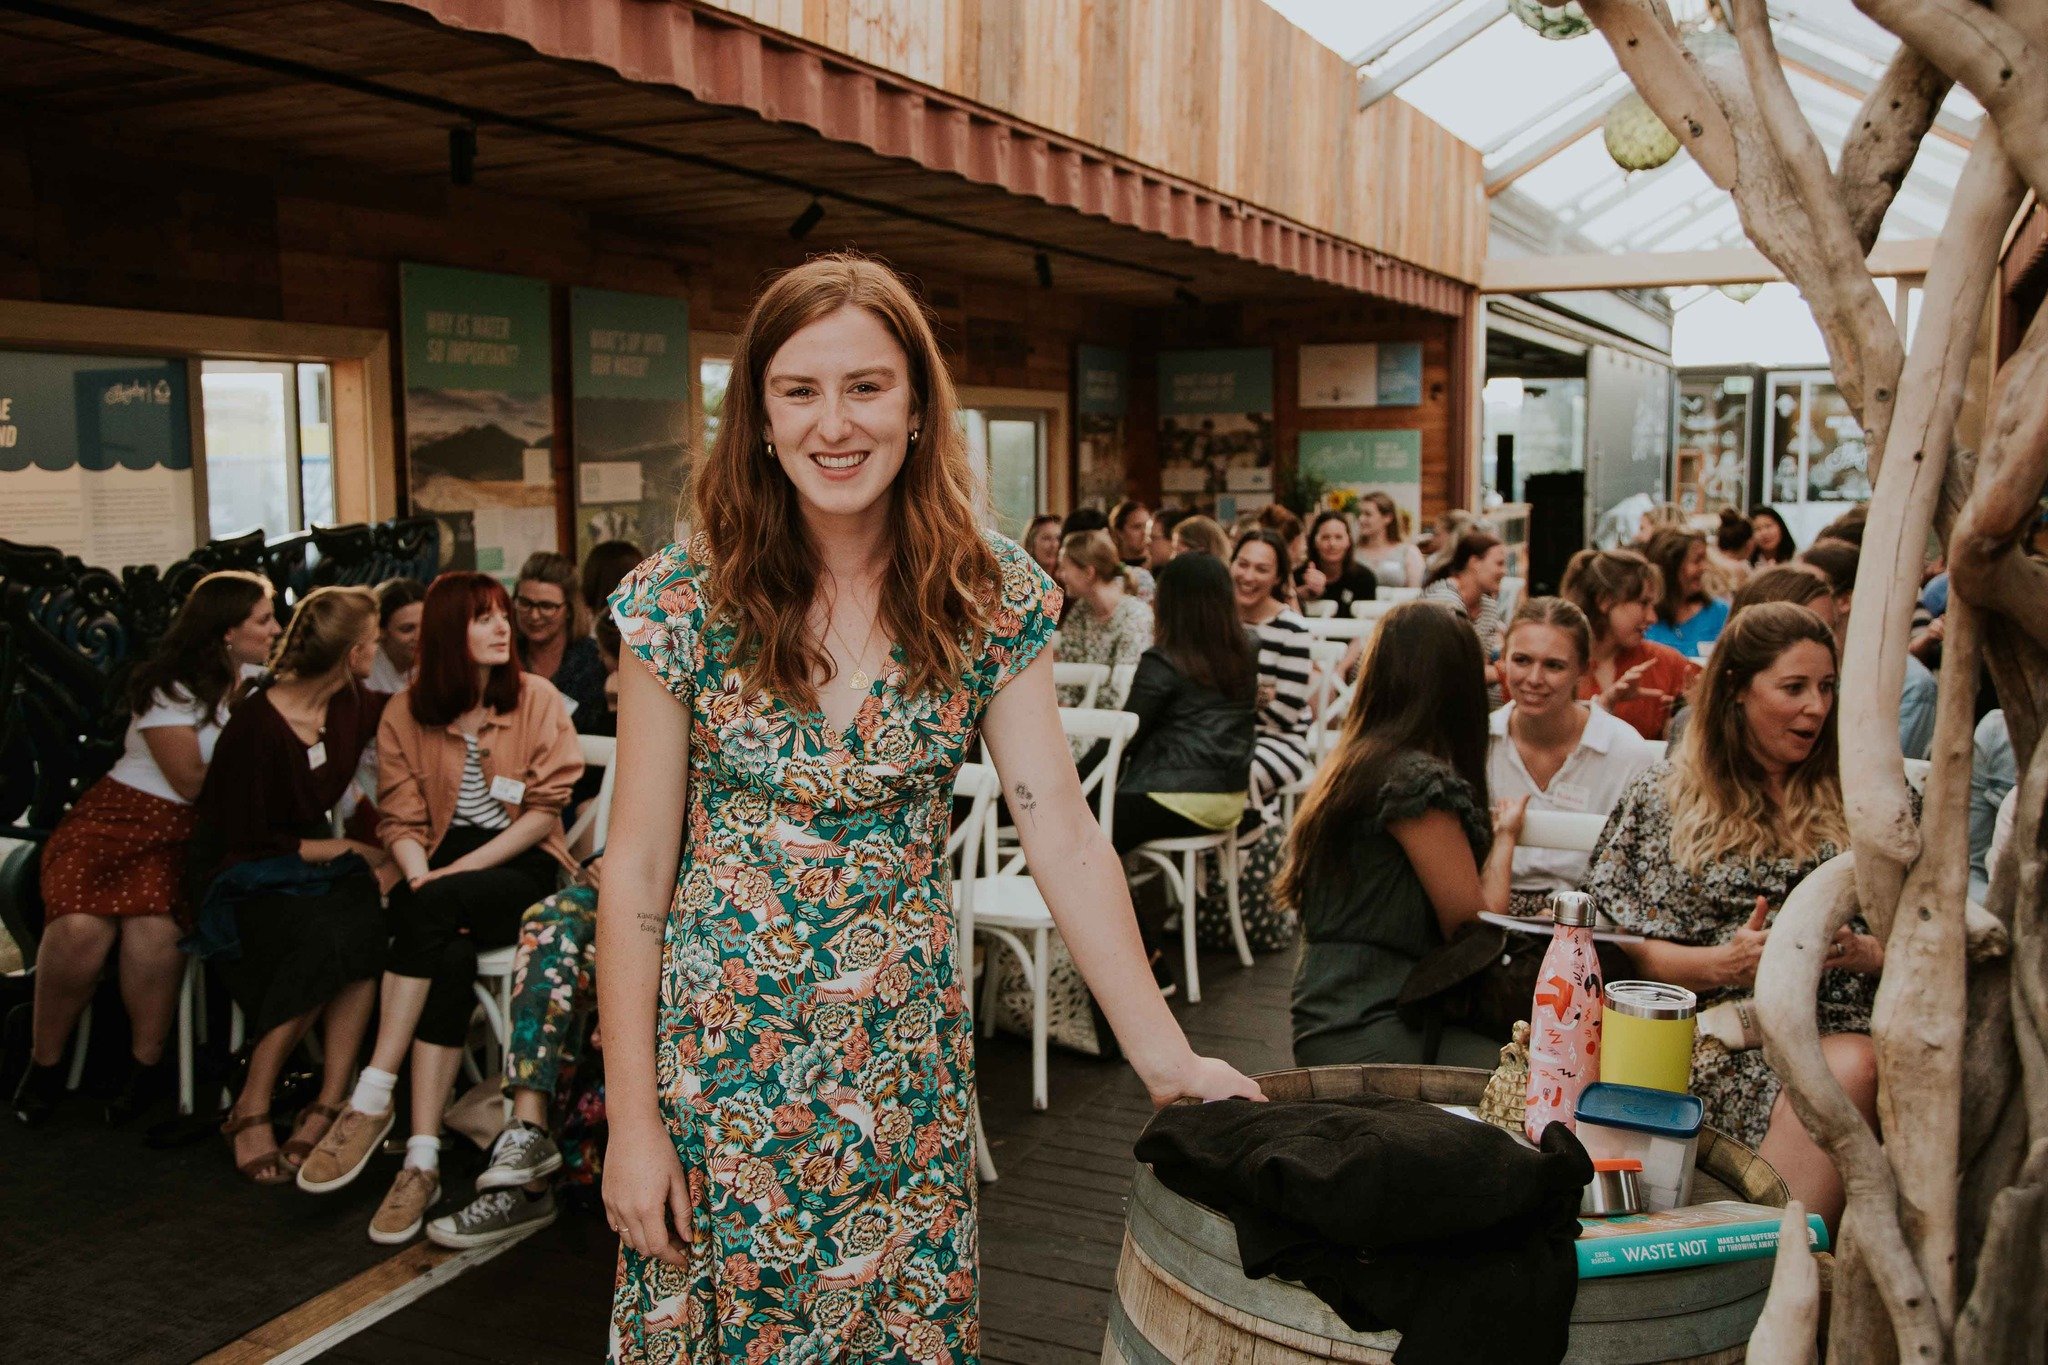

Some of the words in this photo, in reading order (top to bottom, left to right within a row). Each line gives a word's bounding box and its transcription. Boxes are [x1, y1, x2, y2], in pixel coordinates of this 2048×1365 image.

[455, 314, 470, 336] IS
[427, 338, 445, 363] SO
[1717, 1236, 1734, 1245] MAKE
[1735, 1235, 1740, 1243] A
[1740, 1234, 1750, 1242] BIG
[1750, 1231, 1780, 1241] DIFFEREN
[1717, 1245, 1726, 1253] BY
[1727, 1242, 1757, 1252] THROWING
[1758, 1240, 1774, 1249] AWAY
[1622, 1242, 1677, 1262] WASTE
[1678, 1239, 1708, 1257] NOT
